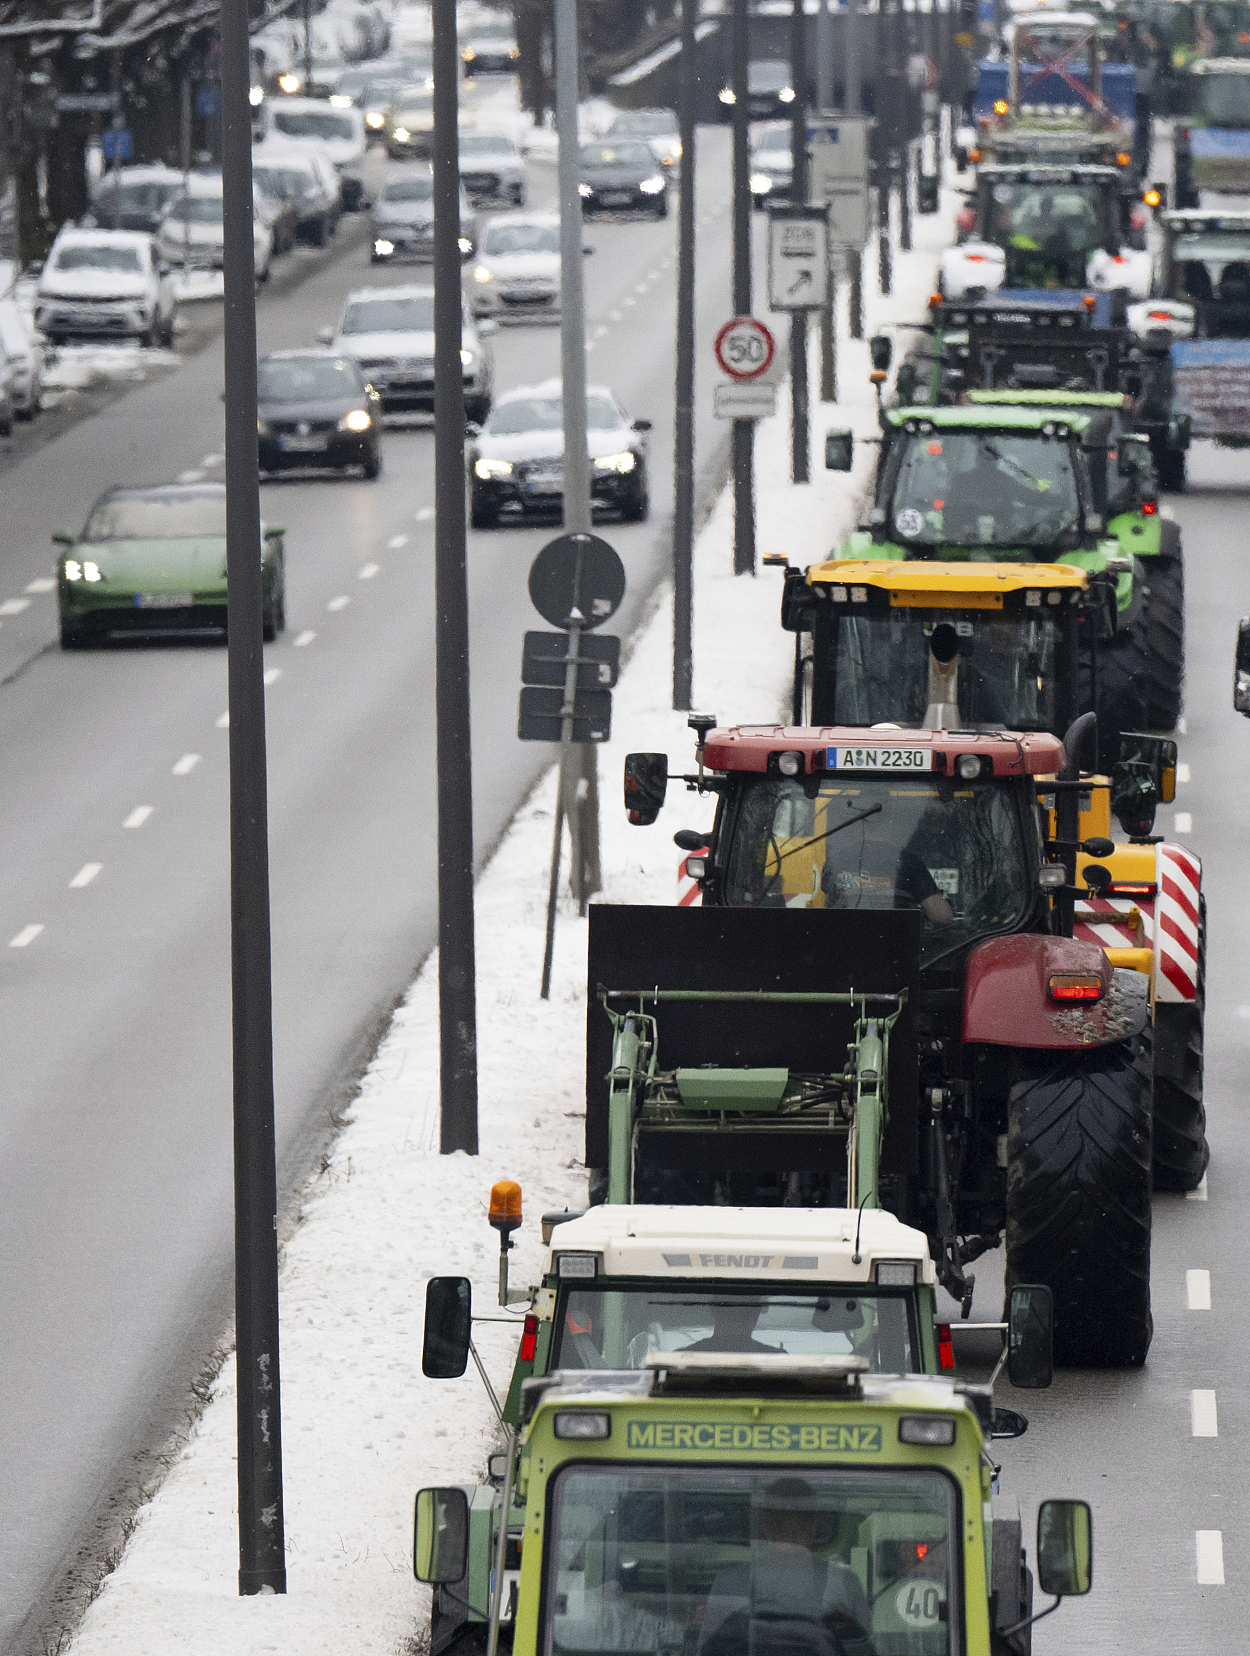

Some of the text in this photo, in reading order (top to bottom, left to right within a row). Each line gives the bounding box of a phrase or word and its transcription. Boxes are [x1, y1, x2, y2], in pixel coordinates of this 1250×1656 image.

[728, 336, 763, 363] 50
[923, 621, 974, 637] JB
[843, 750, 854, 766] A
[866, 750, 877, 766] N
[881, 750, 924, 767] 2230
[699, 1253, 774, 1268] FENDT
[630, 1423, 880, 1450] MERCEDES-BENZ
[905, 1587, 940, 1619] 40
